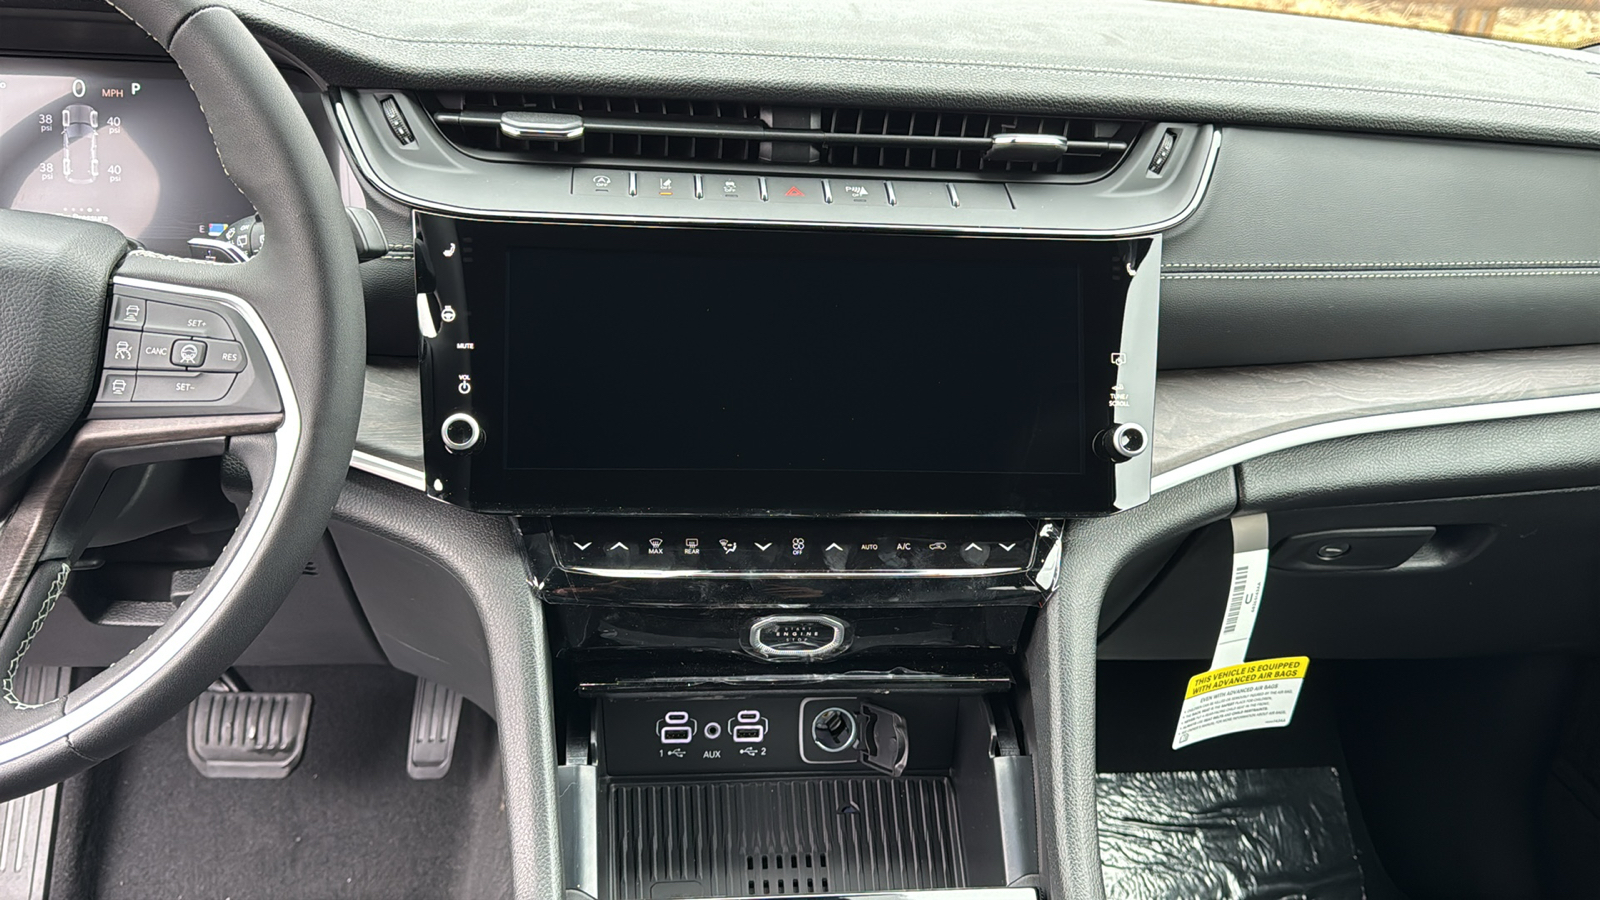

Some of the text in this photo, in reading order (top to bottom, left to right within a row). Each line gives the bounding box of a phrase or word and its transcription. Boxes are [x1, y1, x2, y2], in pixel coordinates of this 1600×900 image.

[72, 79, 141, 98] 0 MPH P
[38, 114, 53, 124] 38
[106, 117, 121, 127] 40
[41, 124, 52, 132] psi
[109, 126, 121, 134] psi
[40, 163, 53, 173] 38
[107, 165, 121, 175] 40
[42, 173, 54, 181] psi
[109, 174, 121, 182] psi
[187, 319, 207, 327] SET+
[456, 342, 475, 350] MUTE
[145, 347, 168, 355] CANC
[221, 353, 238, 361] RES
[861, 543, 878, 551] AUTO
[896, 542, 911, 551] A/C
[1195, 661, 1301, 687] THIS VEHICLE IS EQUIPPED
[1192, 669, 1298, 695] WITH ADVANCED AIR BAGS
[1227, 686, 1254, 697] ADVANCED
[659, 749, 664, 757] 1
[702, 750, 721, 759] AUX
[760, 747, 767, 756] 2
